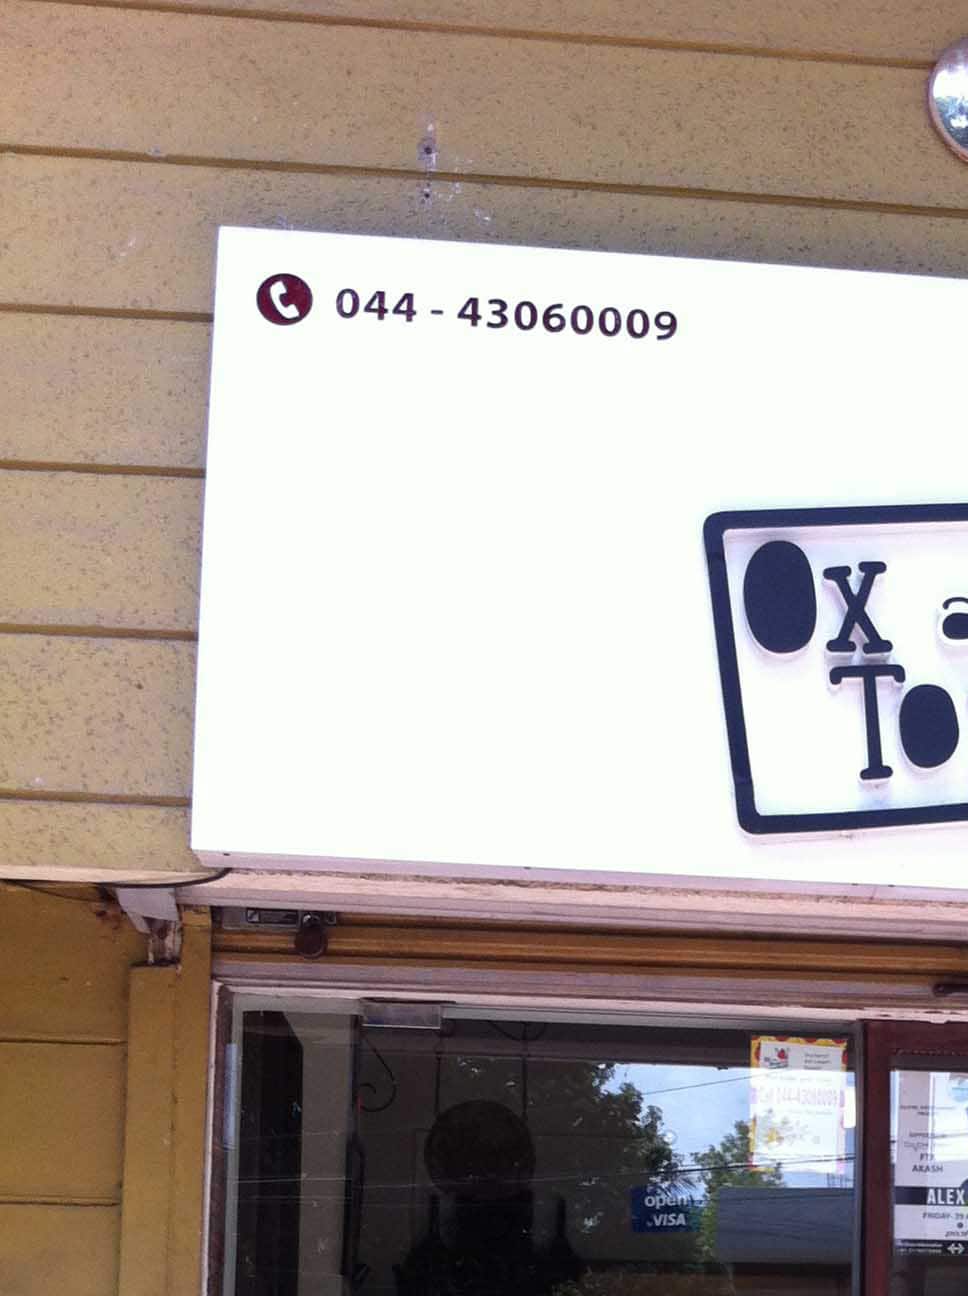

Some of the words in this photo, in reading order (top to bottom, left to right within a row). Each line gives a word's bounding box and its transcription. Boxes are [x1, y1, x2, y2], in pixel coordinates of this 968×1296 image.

[337, 288, 417, 322] 044
[457, 297, 678, 340] 43060009
[911, 1164, 944, 1173] AKASH
[927, 1188, 965, 1206] ALEX
[652, 1213, 687, 1226] VISA
